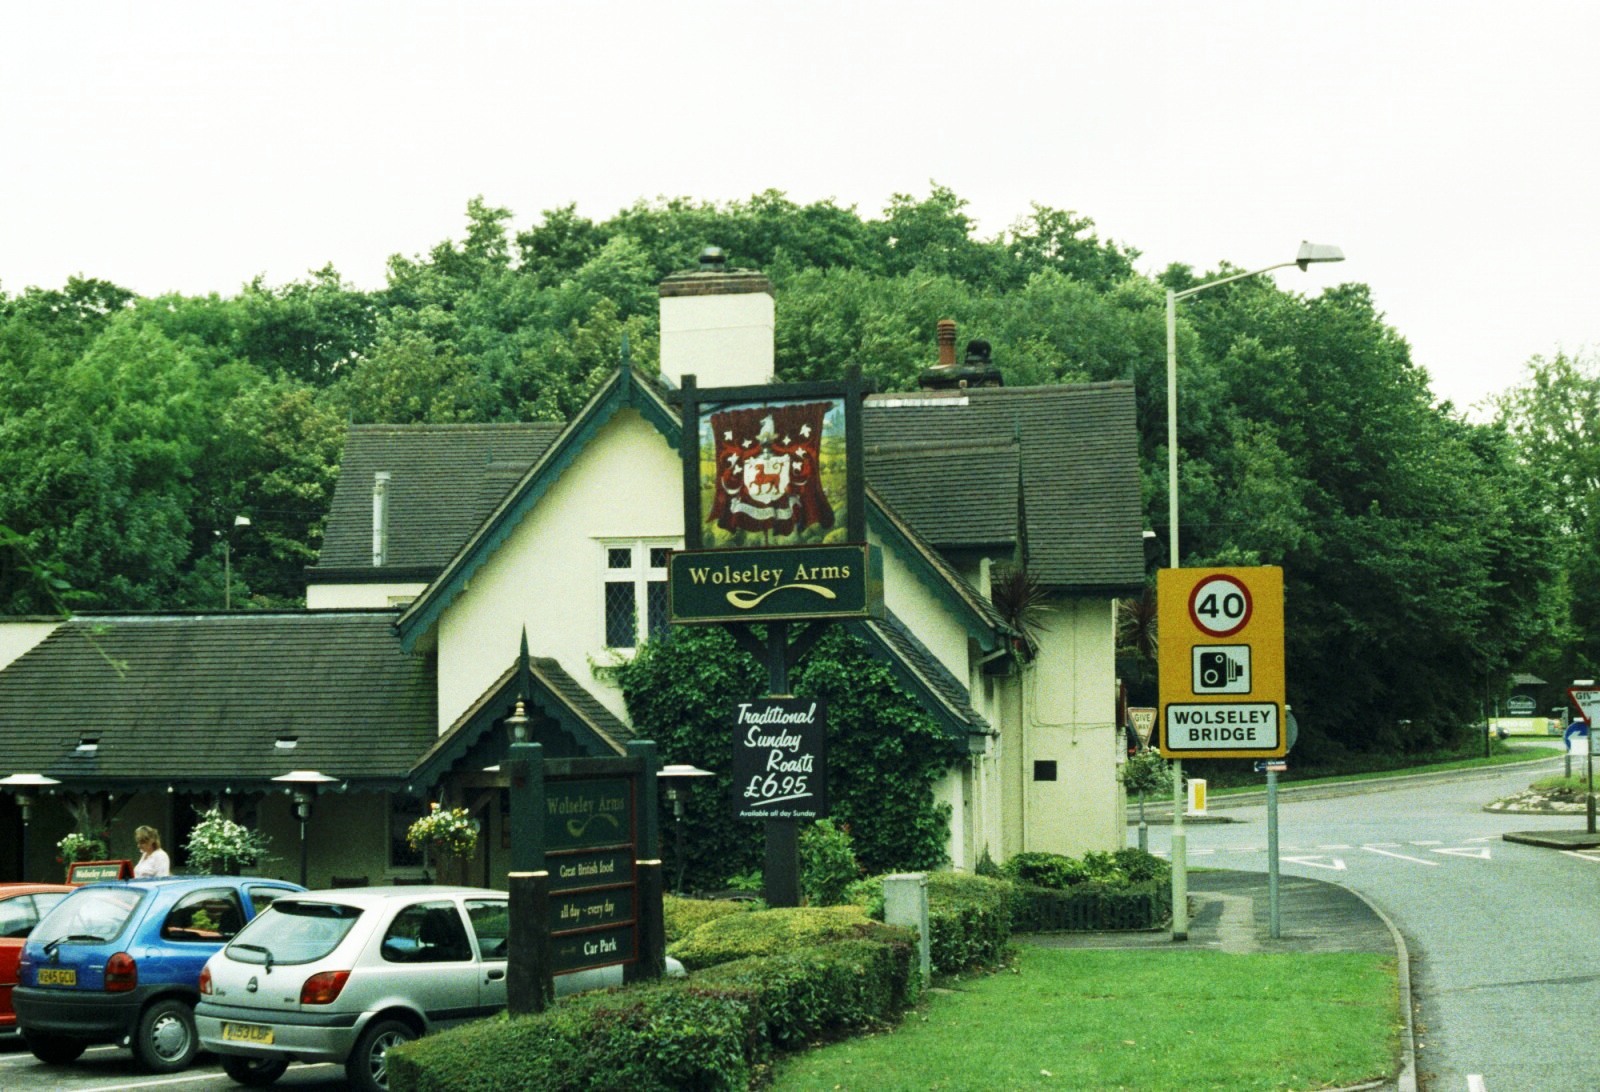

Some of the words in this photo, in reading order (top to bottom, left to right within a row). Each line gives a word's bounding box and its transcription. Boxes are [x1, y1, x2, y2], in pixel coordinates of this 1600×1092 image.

[689, 565, 783, 586] Wolseley
[795, 563, 850, 580] Arms
[1198, 592, 1244, 619] 40
[737, 702, 817, 725] Traditional
[1134, 713, 1151, 722] GIVE
[1174, 710, 1271, 724] WOLSELEY
[743, 725, 802, 752] Sunday
[1189, 727, 1257, 741] BRIDGE
[766, 749, 815, 773] Roasts
[743, 773, 808, 798] £6.95
[546, 796, 594, 816] Wolseley
[598, 796, 625, 811] Arms
[740, 809, 769, 817] Available
[770, 809, 779, 817] all
[780, 809, 791, 818] day
[793, 809, 816, 818] Sunday
[560, 865, 576, 878] Great
[578, 861, 598, 876] British
[600, 859, 614, 873] food
[561, 904, 569, 919] all
[570, 903, 580, 922] day
[587, 905, 603, 919] every
[604, 899, 614, 917] day
[584, 941, 598, 955] Car
[600, 938, 617, 953] Park
